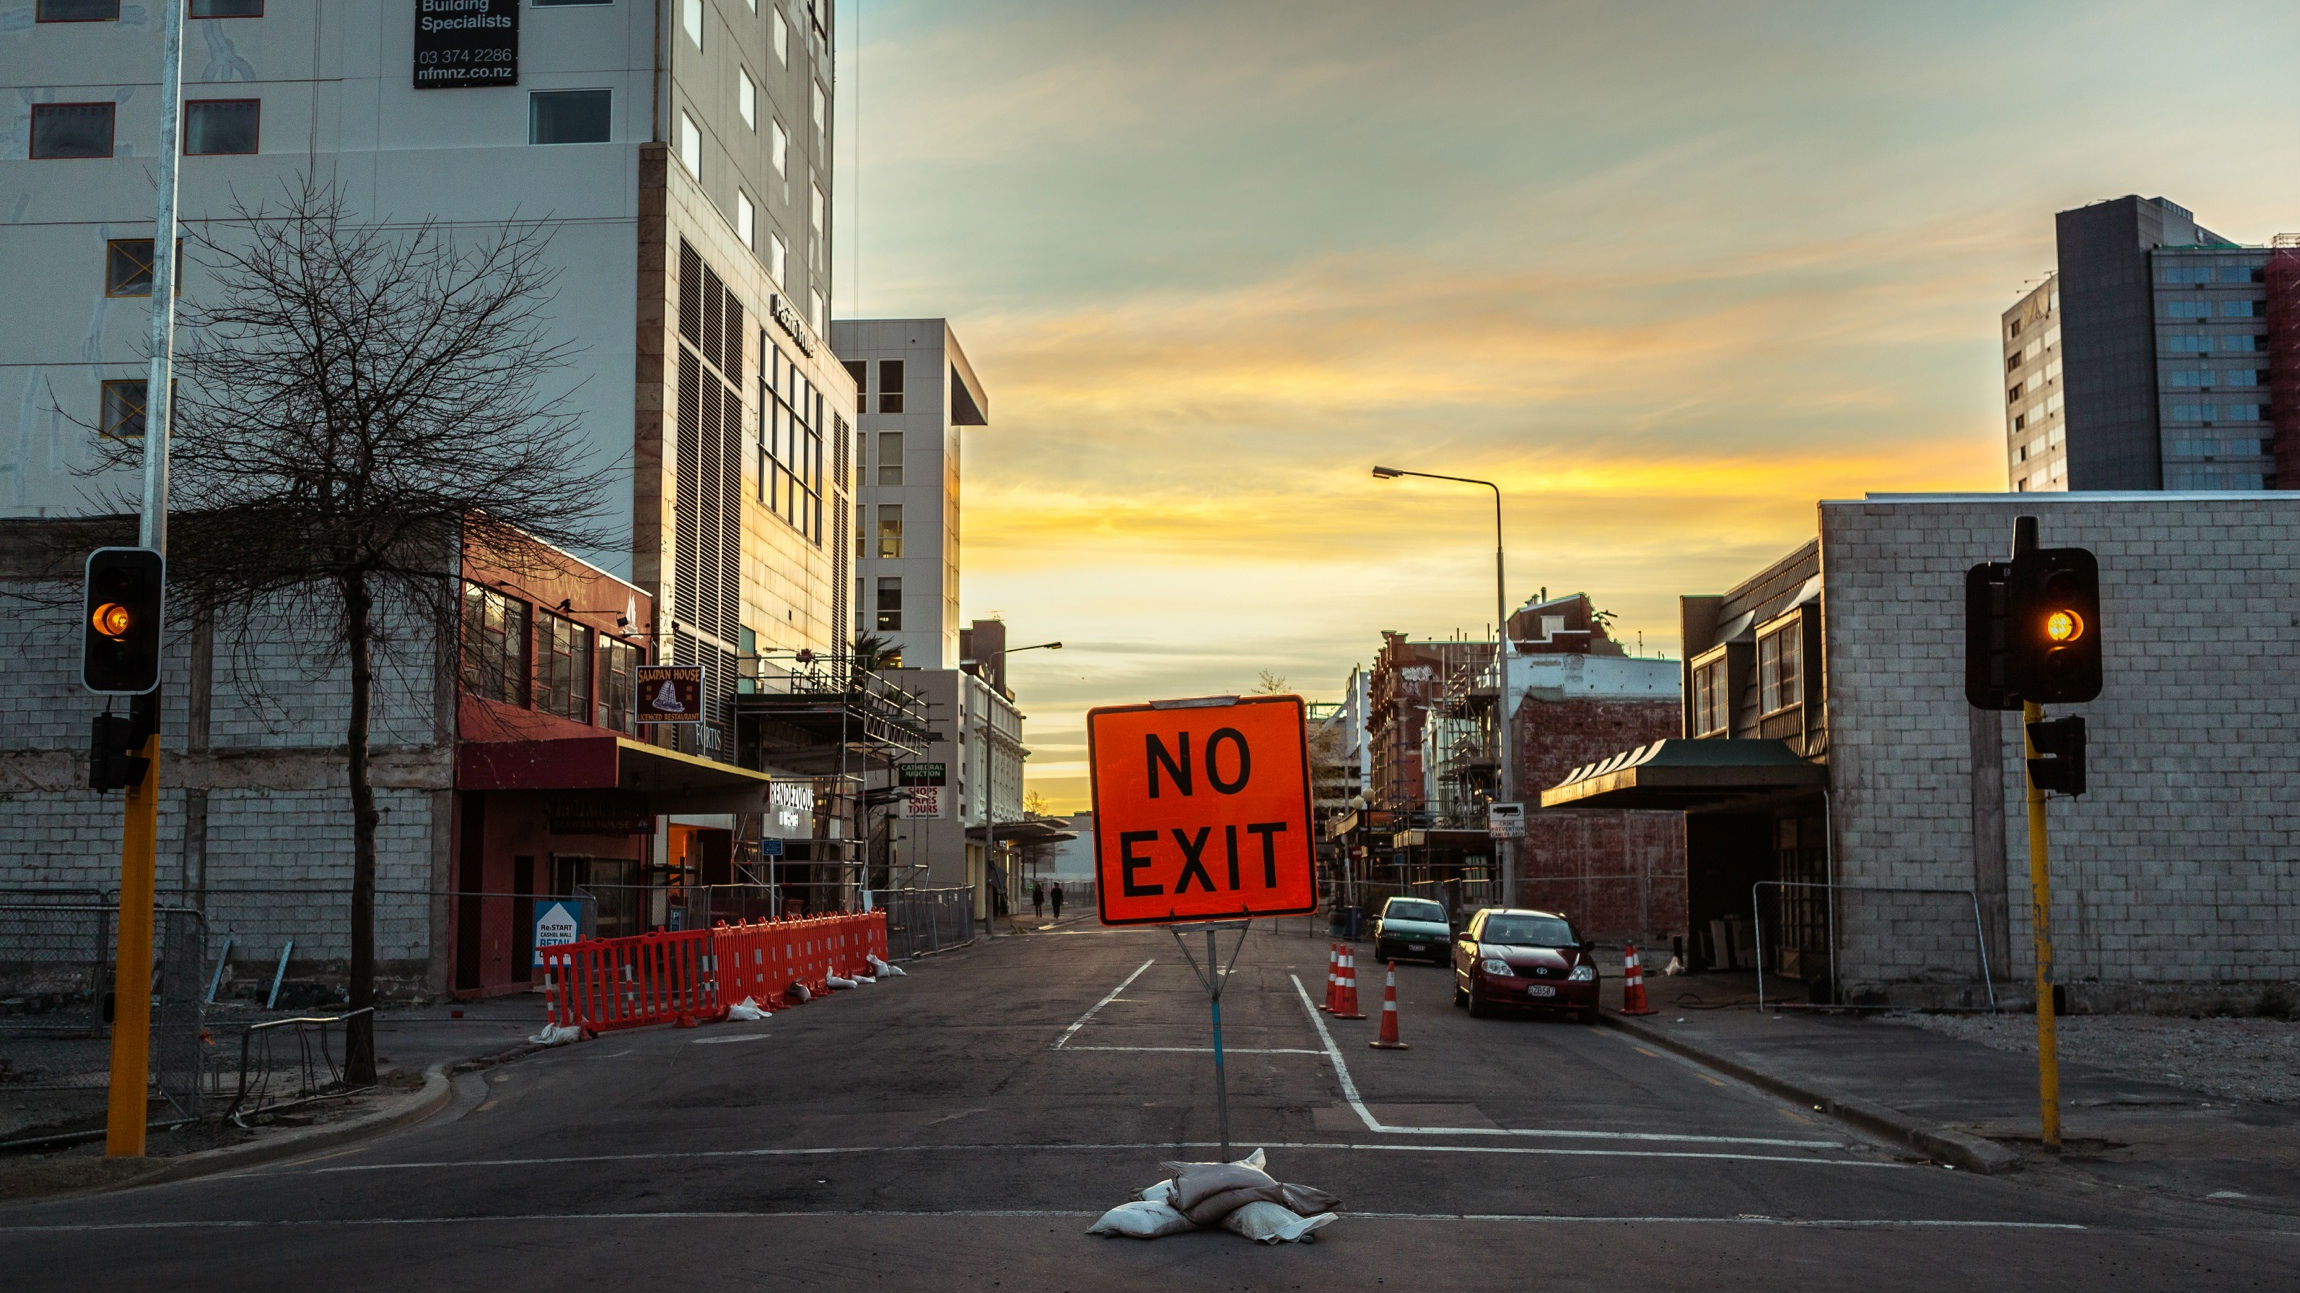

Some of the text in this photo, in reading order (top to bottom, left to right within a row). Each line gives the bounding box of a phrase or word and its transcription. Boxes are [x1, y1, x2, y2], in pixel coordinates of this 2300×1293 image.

[422, 0, 489, 12] Building
[421, 14, 512, 33] Specialists
[419, 49, 512, 64] 03 374 2286
[418, 66, 512, 80] nfmnz.co.nz
[638, 668, 700, 683] SAMPAN HOUSE
[664, 712, 700, 721] RESTAURANT
[1145, 727, 1251, 799] NO
[907, 804, 938, 814] TOURS
[1120, 821, 1287, 898] EXIT
[673, 911, 680, 920] P
